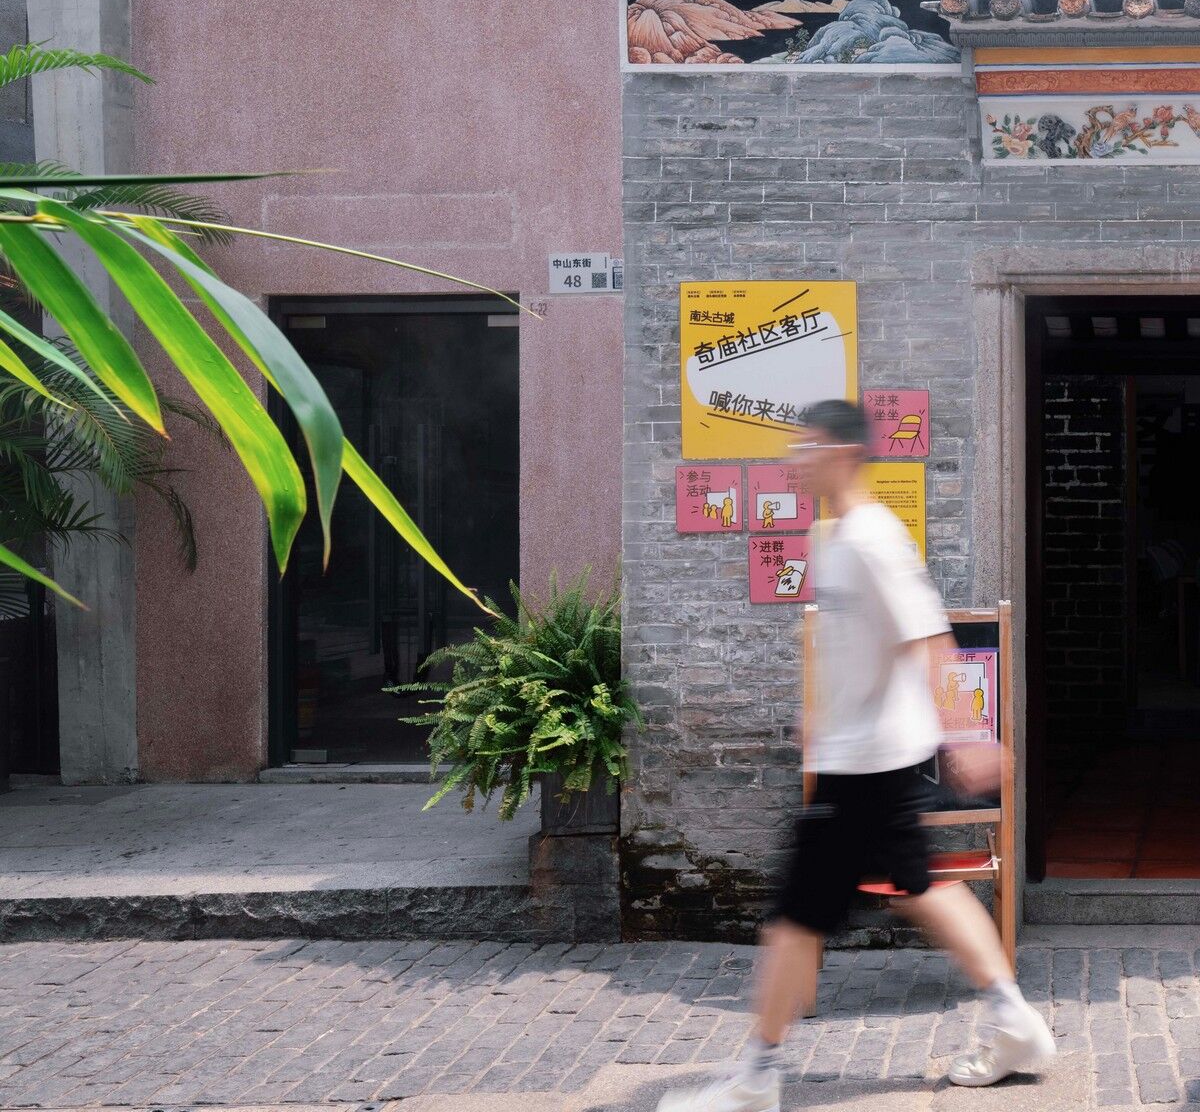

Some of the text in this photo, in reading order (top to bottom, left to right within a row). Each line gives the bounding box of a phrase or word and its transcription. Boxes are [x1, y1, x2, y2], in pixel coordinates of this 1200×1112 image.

[552, 258, 591, 269] 中山东街
[563, 274, 582, 288] 48
[690, 309, 735, 324] 南头古城
[693, 307, 822, 365] 奇庙社区客厅
[874, 394, 899, 407] 进来
[874, 408, 899, 421] 坐坐
[686, 470, 711, 483] 参与
[686, 484, 712, 498] 活动
[759, 541, 784, 554] 进群
[760, 554, 785, 567] 冲浪
